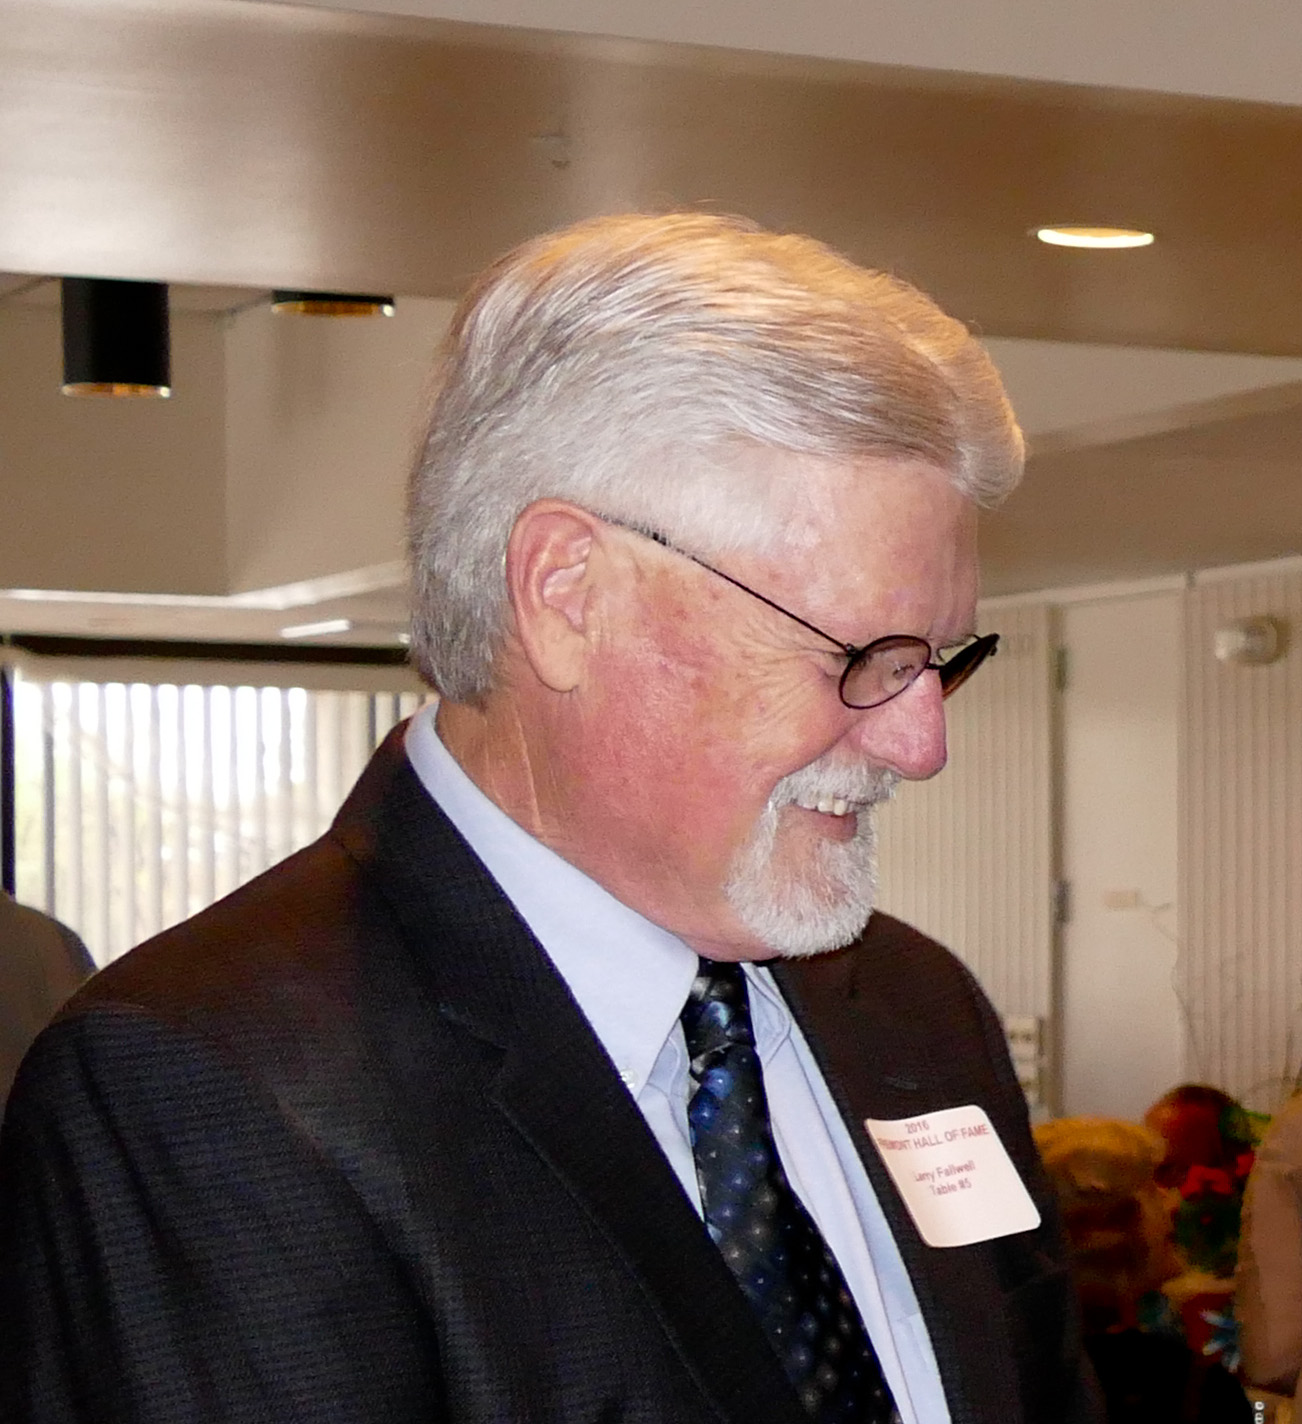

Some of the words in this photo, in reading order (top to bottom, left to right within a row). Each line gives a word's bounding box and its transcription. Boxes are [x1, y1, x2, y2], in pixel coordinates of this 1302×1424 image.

[906, 1120, 929, 1133] 2016
[913, 1133, 943, 1149] HALL
[944, 1128, 961, 1142] OF
[961, 1124, 989, 1138] FAME
[930, 1183, 957, 1195] Table
